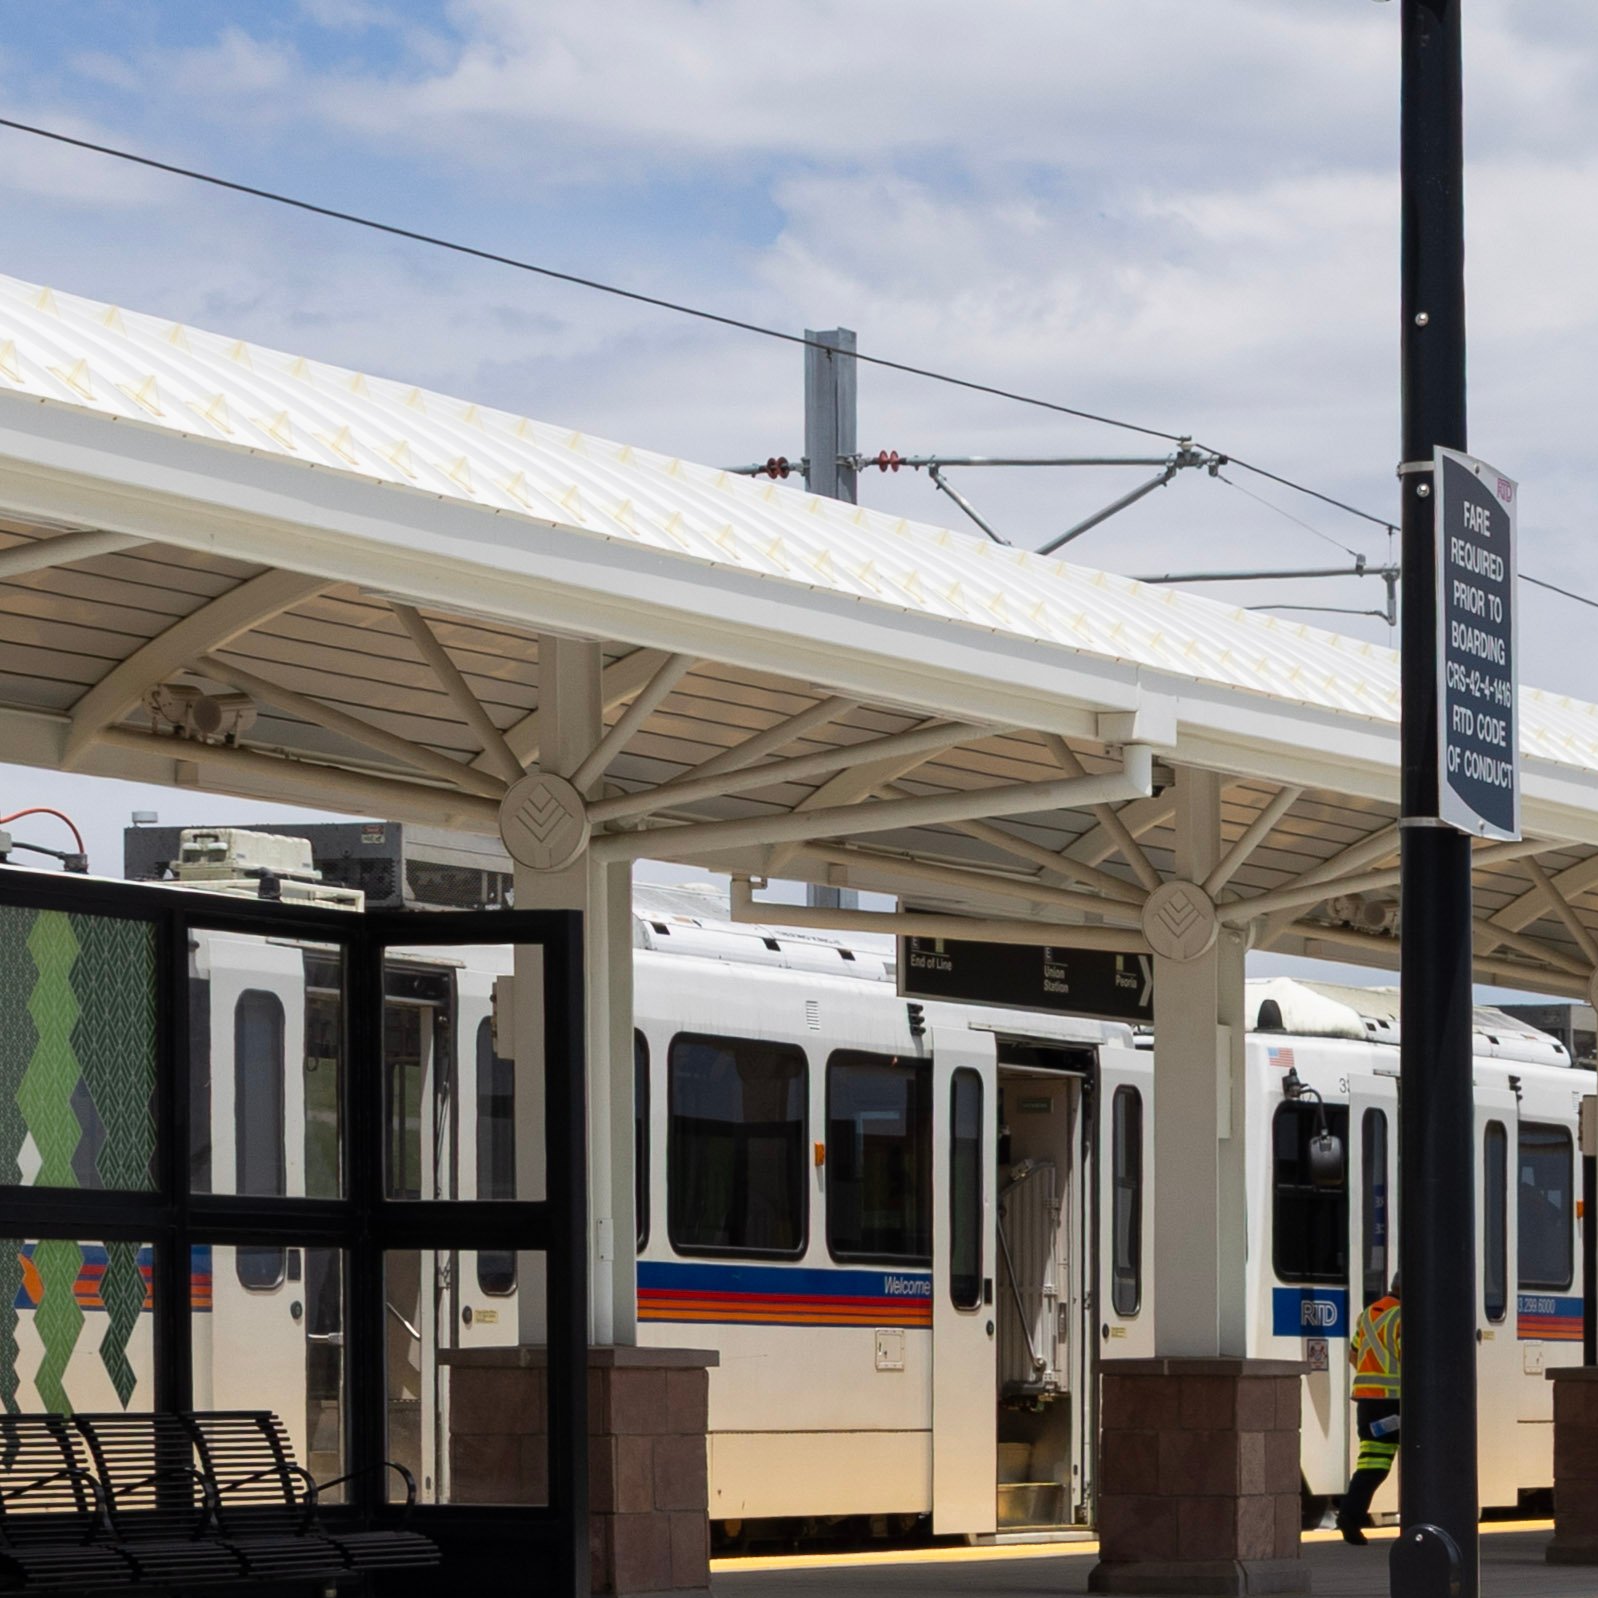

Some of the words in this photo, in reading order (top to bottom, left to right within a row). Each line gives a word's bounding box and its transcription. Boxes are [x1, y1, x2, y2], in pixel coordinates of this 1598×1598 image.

[1463, 500, 1491, 537] FARE
[1451, 536, 1504, 583] REQUIRED
[1453, 579, 1485, 618] PRIOR
[1488, 593, 1502, 624] TO
[1451, 620, 1505, 666] BOARDING
[1446, 660, 1511, 708] CRS-42-4-1416
[1453, 704, 1474, 736] RTD
[1477, 713, 1506, 748] CODE
[1447, 744, 1461, 773] OF
[1464, 750, 1512, 789] CONDUCT
[911, 954, 926, 968] End
[927, 957, 935, 969] of
[936, 958, 952, 972] Line
[1044, 965, 1065, 979] Union
[1115, 974, 1137, 989] Peoria
[1044, 979, 1069, 993] Station
[884, 1275, 931, 1295] Welcome
[1301, 1300, 1338, 1326] RTD
